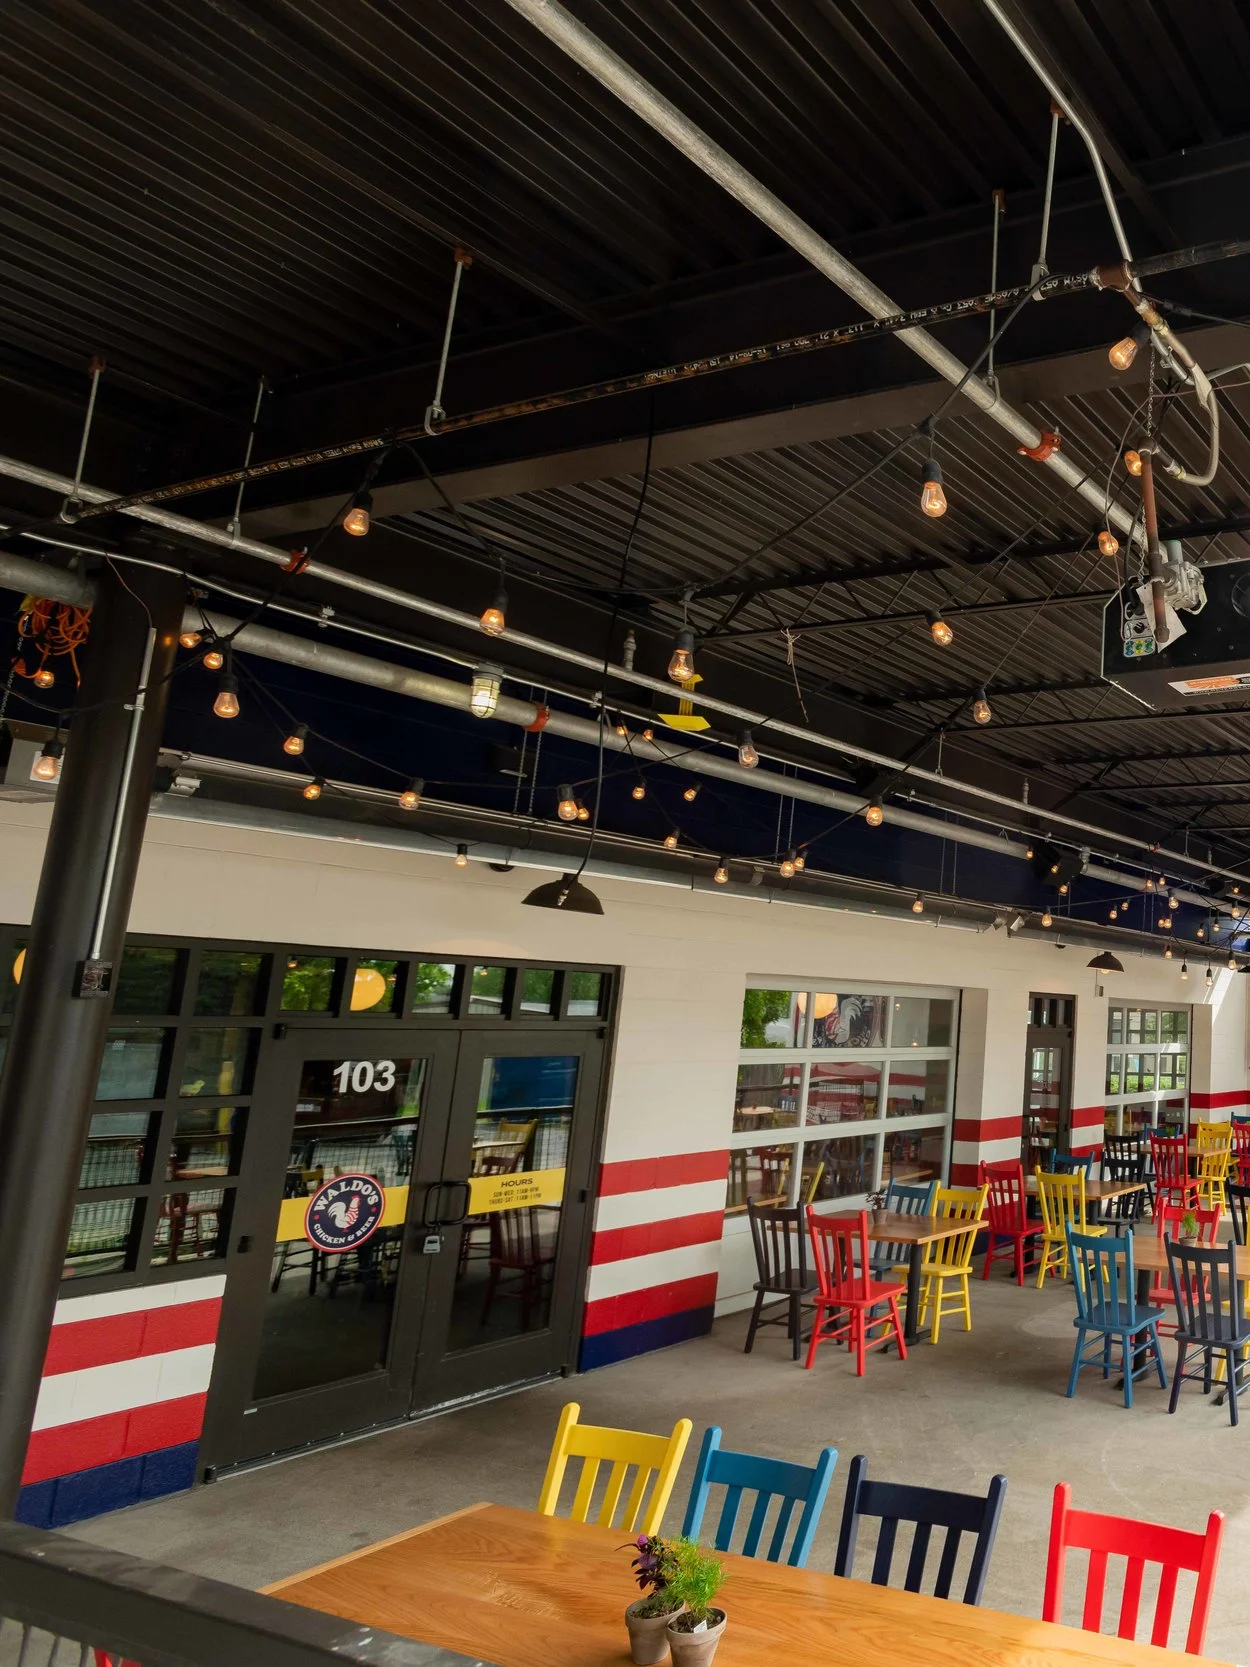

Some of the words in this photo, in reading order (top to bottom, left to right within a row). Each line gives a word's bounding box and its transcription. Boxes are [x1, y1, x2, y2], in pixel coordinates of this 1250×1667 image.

[333, 1060, 396, 1094] 103
[313, 1180, 379, 1211] WALDO'S
[501, 1177, 533, 1188] HOURS
[313, 1223, 346, 1244] CHICKEN
[347, 1234, 355, 1242] &
[355, 1216, 376, 1237] BEER
